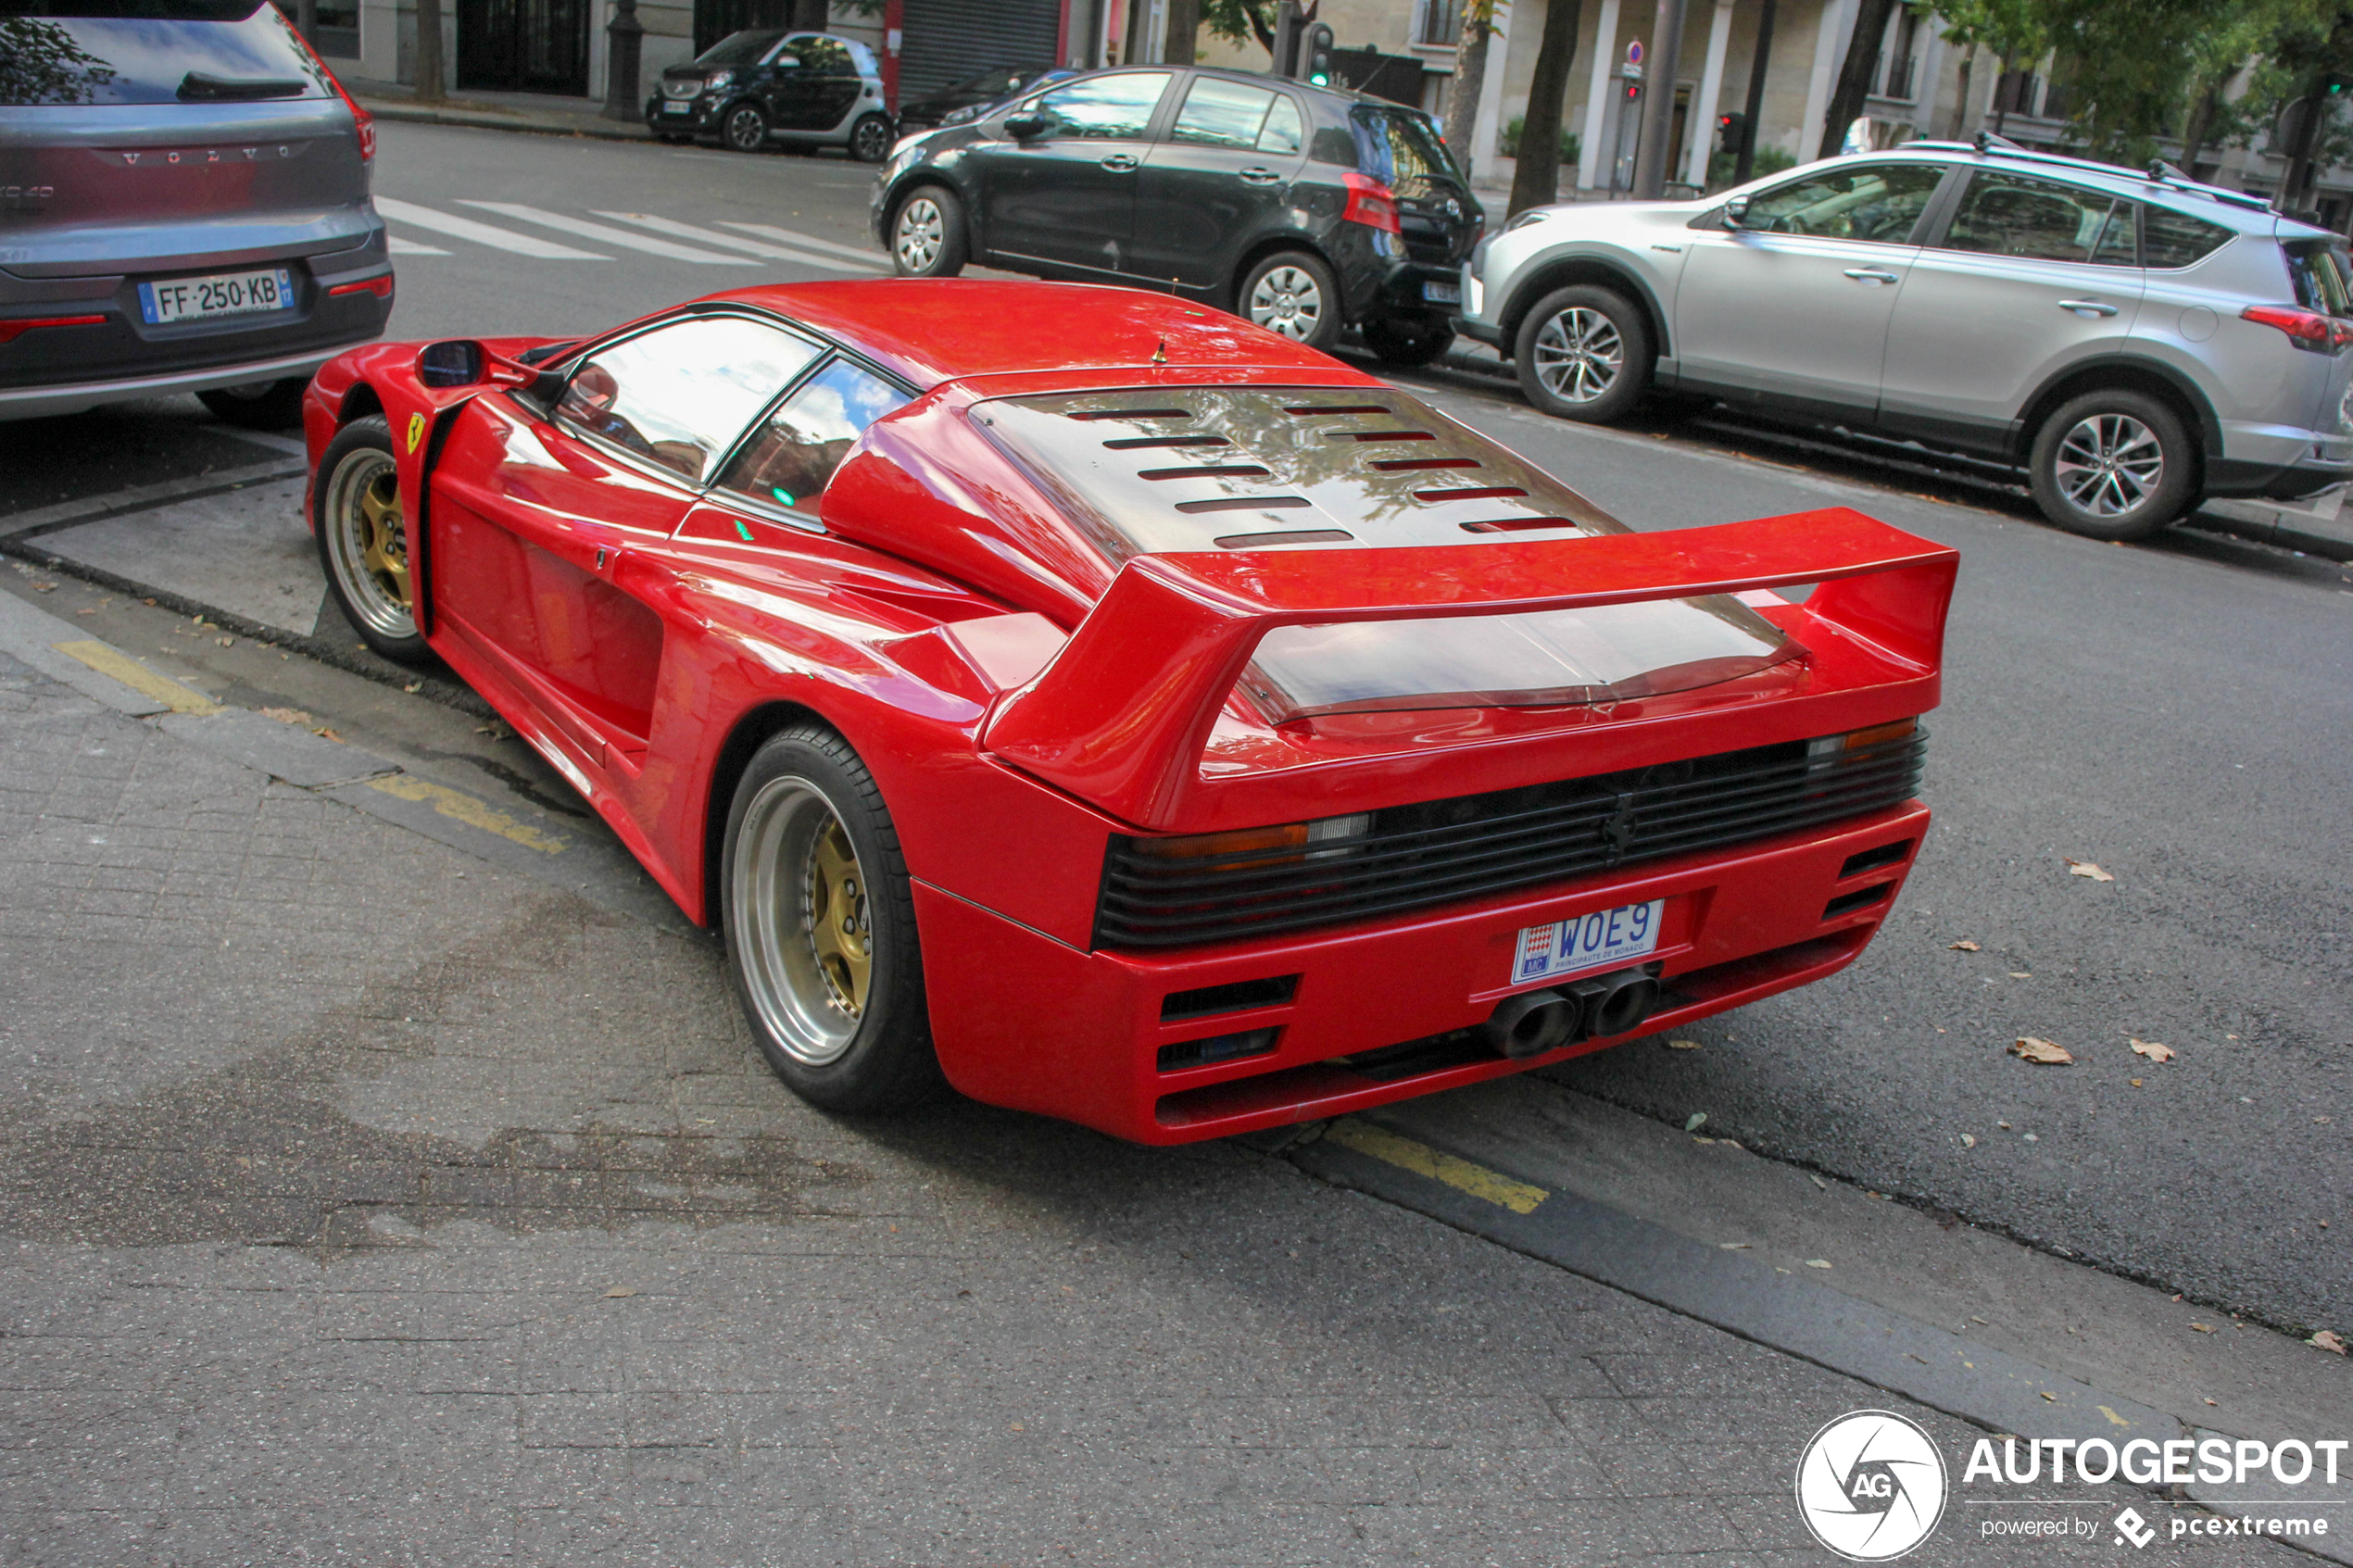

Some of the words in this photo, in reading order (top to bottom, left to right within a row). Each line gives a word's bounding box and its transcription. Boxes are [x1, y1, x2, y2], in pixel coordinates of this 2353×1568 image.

[124, 146, 289, 164] VOLVO
[1527, 958, 1543, 972] MC
[1555, 952, 1602, 969] PRINCIPAUTE
[1603, 950, 1613, 959] DE
[1615, 943, 1644, 956] MONACO
